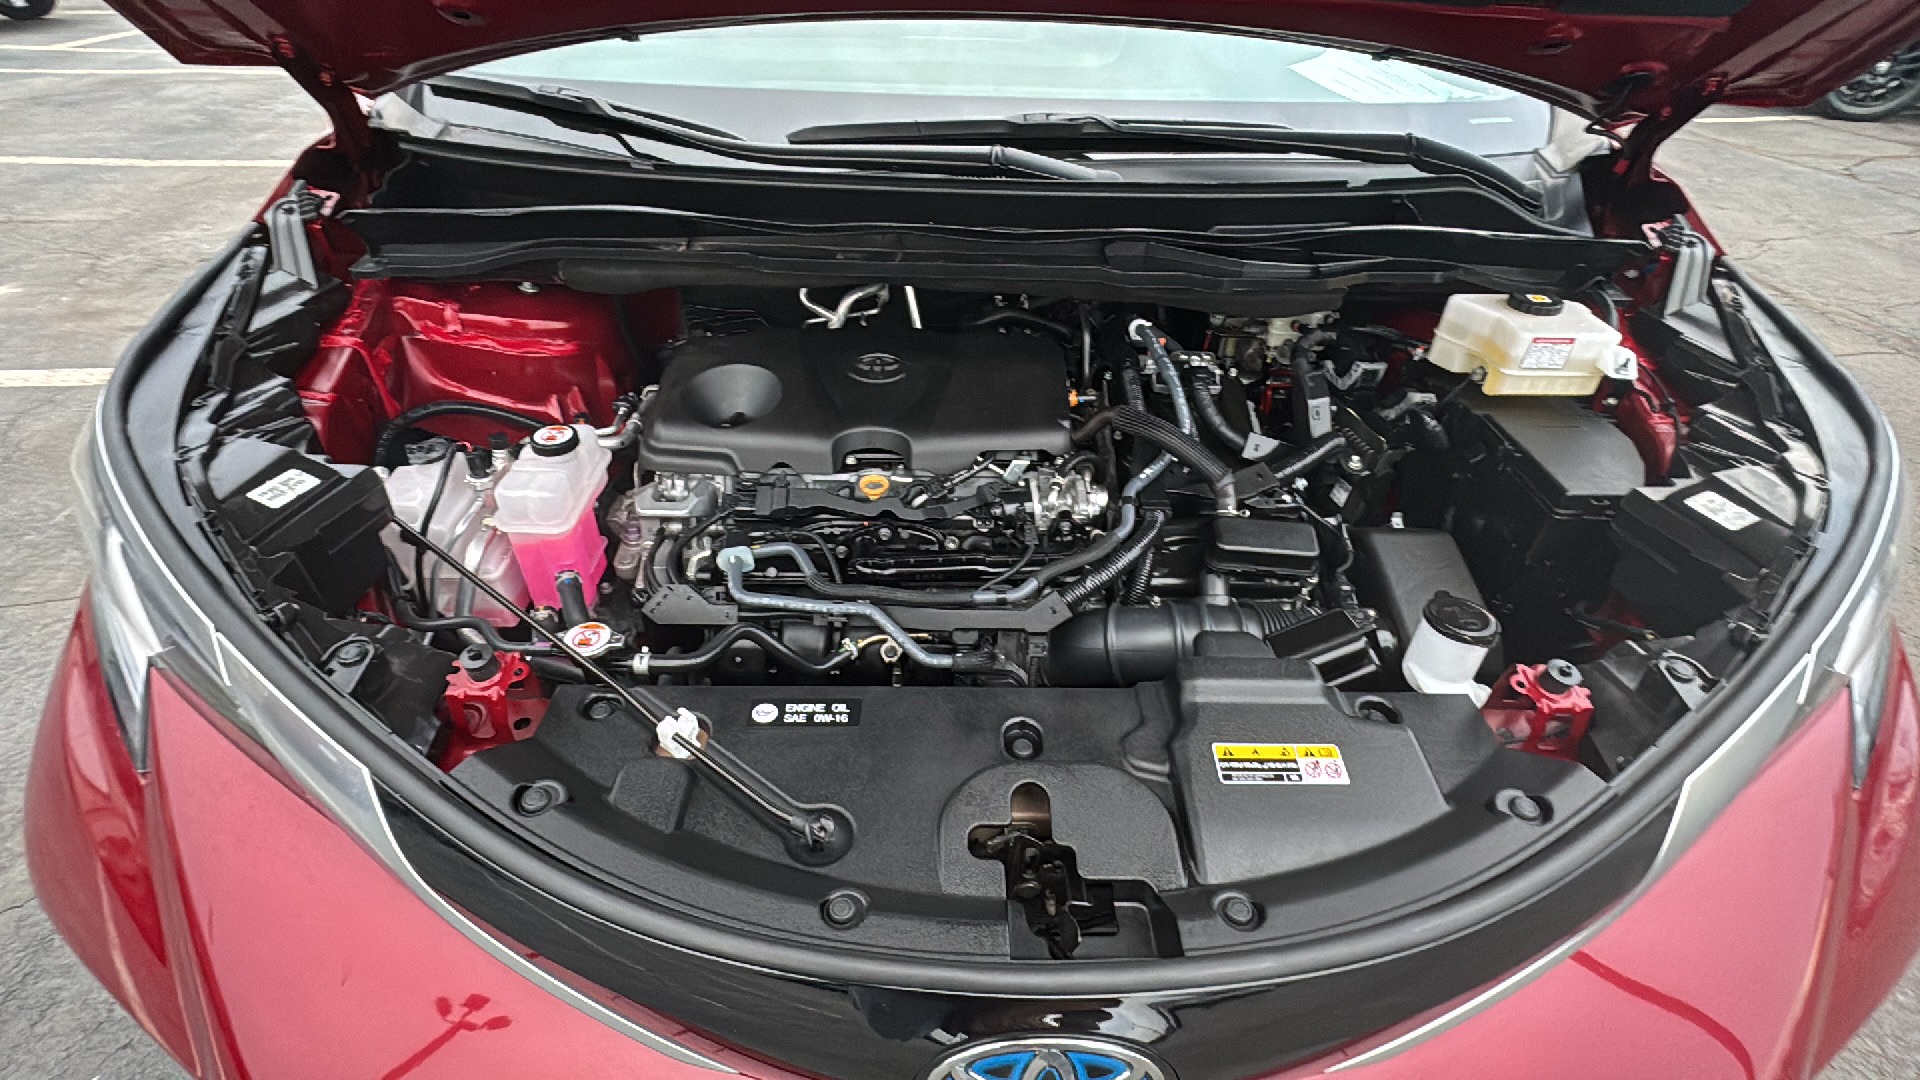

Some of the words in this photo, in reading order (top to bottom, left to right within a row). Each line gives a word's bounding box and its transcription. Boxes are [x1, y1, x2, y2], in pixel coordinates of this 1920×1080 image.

[785, 704, 826, 712] ENGINE
[831, 704, 850, 712] OIL
[784, 714, 807, 722] SAE
